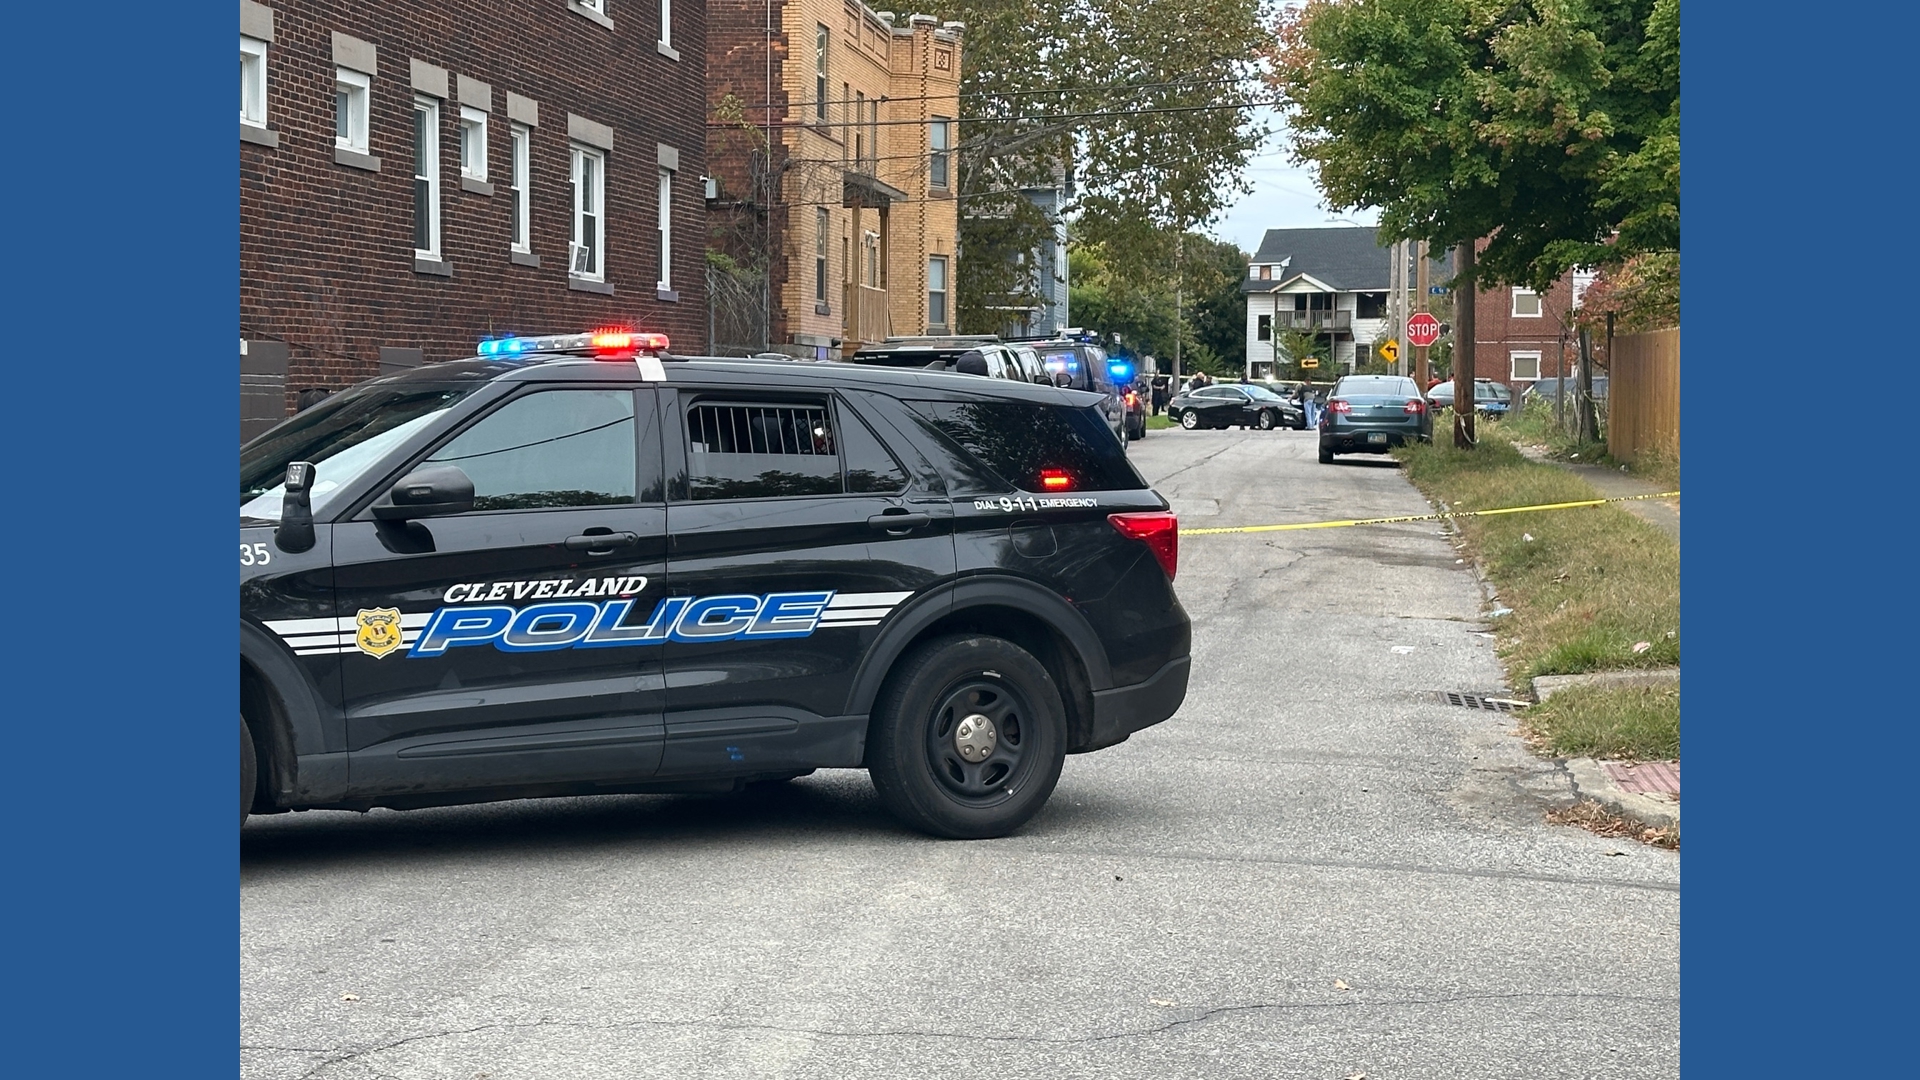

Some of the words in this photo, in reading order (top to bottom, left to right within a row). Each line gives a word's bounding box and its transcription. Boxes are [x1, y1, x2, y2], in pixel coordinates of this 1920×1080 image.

[1408, 323, 1437, 336] STOP
[974, 501, 999, 510] DIAL
[999, 496, 1038, 512] 9-1-1
[1039, 498, 1098, 508] EMERGENCY
[443, 576, 648, 603] CLEVELAND
[406, 589, 838, 658] POLICE
